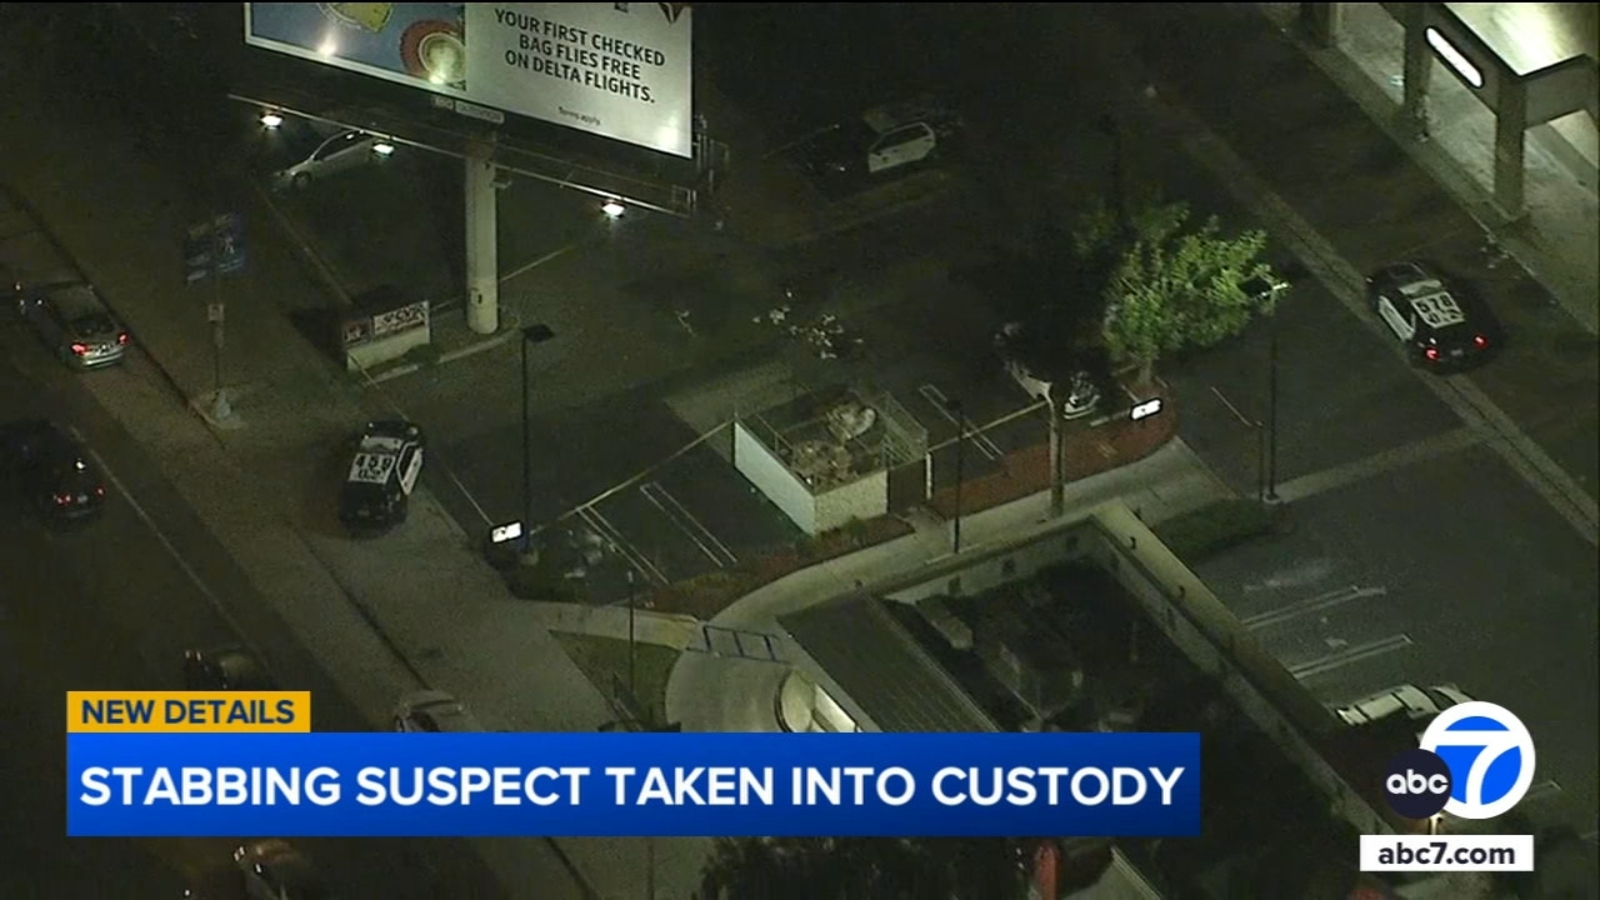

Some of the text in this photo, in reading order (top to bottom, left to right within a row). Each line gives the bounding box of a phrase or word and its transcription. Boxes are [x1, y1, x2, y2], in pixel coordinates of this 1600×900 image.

[494, 8, 666, 67] YOUR FIRST CHECKED
[519, 33, 641, 80] BAG FLIES FREE
[505, 49, 656, 104] ON DELTA FLIGHTS.
[1416, 294, 1453, 315] 578
